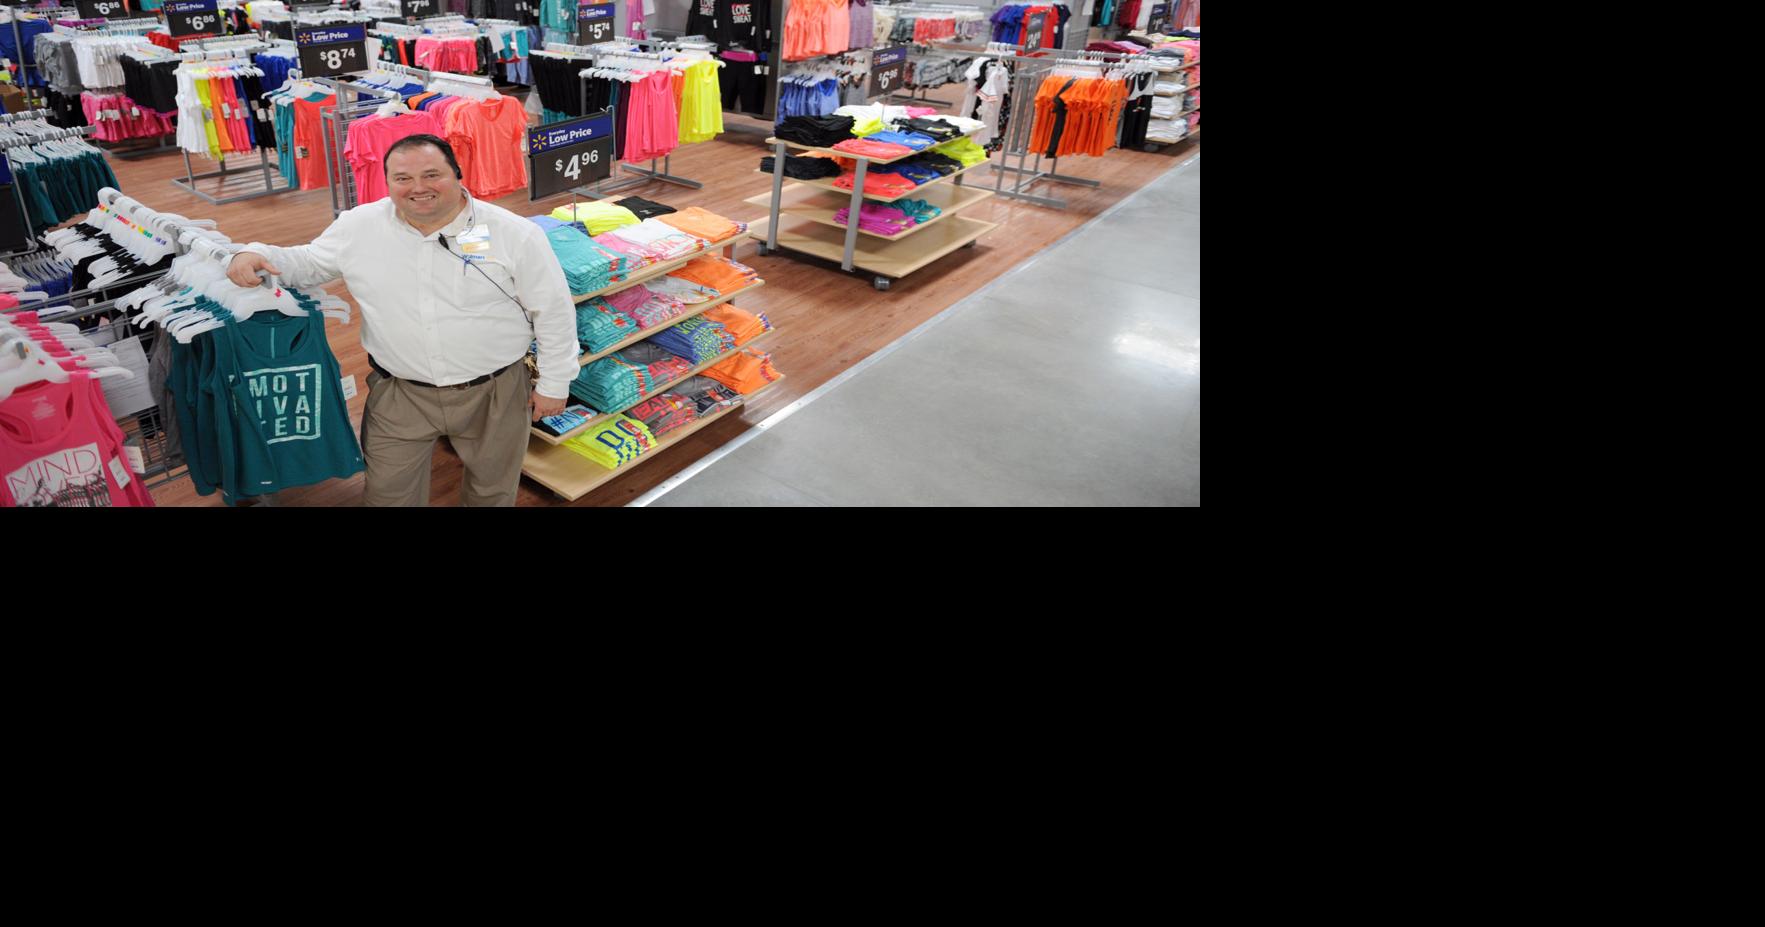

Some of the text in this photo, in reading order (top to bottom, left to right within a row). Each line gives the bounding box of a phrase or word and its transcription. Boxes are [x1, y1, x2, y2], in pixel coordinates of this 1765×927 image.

[549, 133, 568, 145] Low
[569, 128, 592, 140] Price
[249, 372, 310, 398] MOT
[10, 449, 97, 500] MIND
